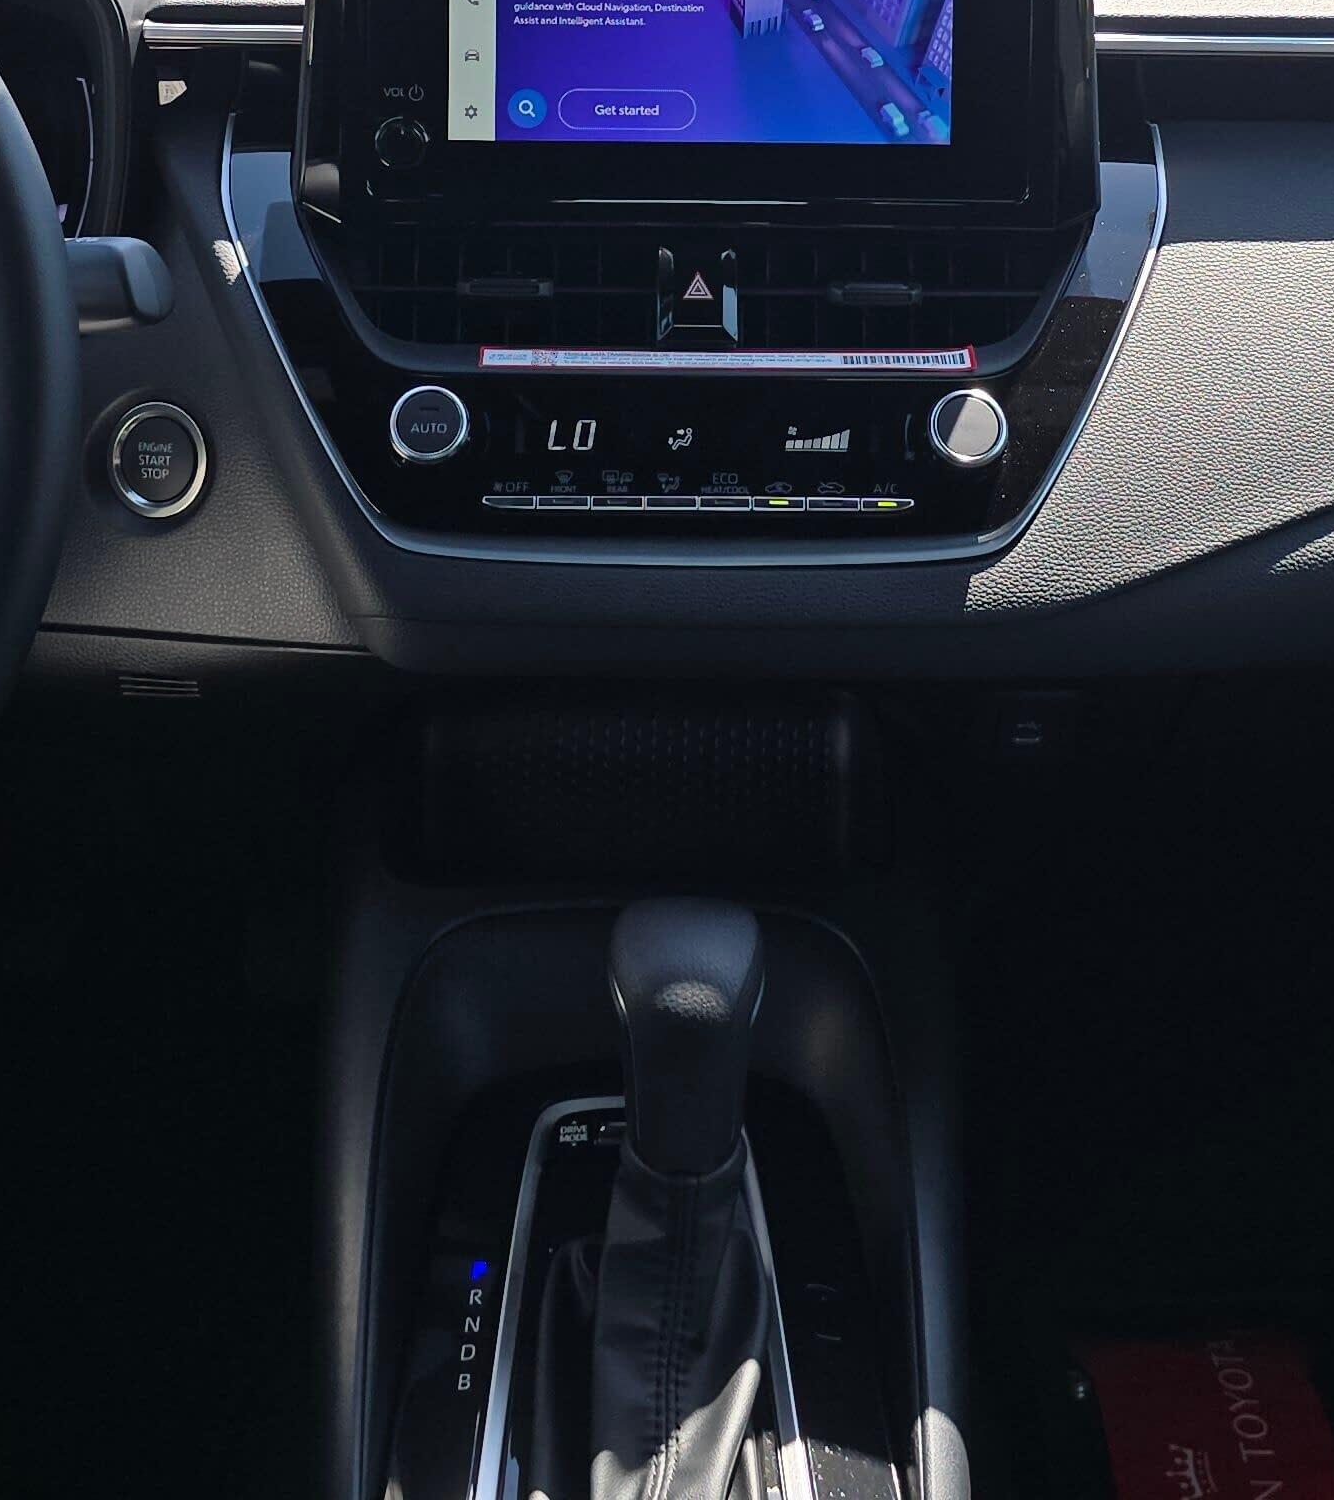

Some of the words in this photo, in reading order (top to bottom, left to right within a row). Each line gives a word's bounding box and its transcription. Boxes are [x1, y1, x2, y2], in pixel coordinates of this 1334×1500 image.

[514, 2, 555, 13] guidance
[556, 2, 574, 12] with
[576, 2, 603, 12] Cloud
[604, 3, 653, 14] Navigation,
[655, 3, 704, 13] Destination
[513, 15, 539, 26] Assist
[540, 16, 557, 26] and
[559, 16, 603, 28] Intelligent
[604, 16, 647, 27] Assistant.
[383, 86, 405, 98] VOL
[594, 103, 618, 117] Get
[621, 103, 659, 117] started
[410, 421, 448, 435] AUTO
[548, 418, 597, 452] LO
[137, 441, 173, 454] ENGINE
[138, 454, 172, 467] START
[140, 467, 170, 480] STOP
[712, 472, 740, 485] ECO
[505, 481, 531, 493] OFF
[550, 484, 578, 494] FRONT
[606, 484, 629, 494] REAR
[700, 485, 750, 495] HEAT/COOL
[873, 482, 899, 495] A/C
[469, 1288, 483, 1305] R
[464, 1316, 481, 1333] N
[460, 1344, 476, 1361] D
[457, 1373, 471, 1391] B
